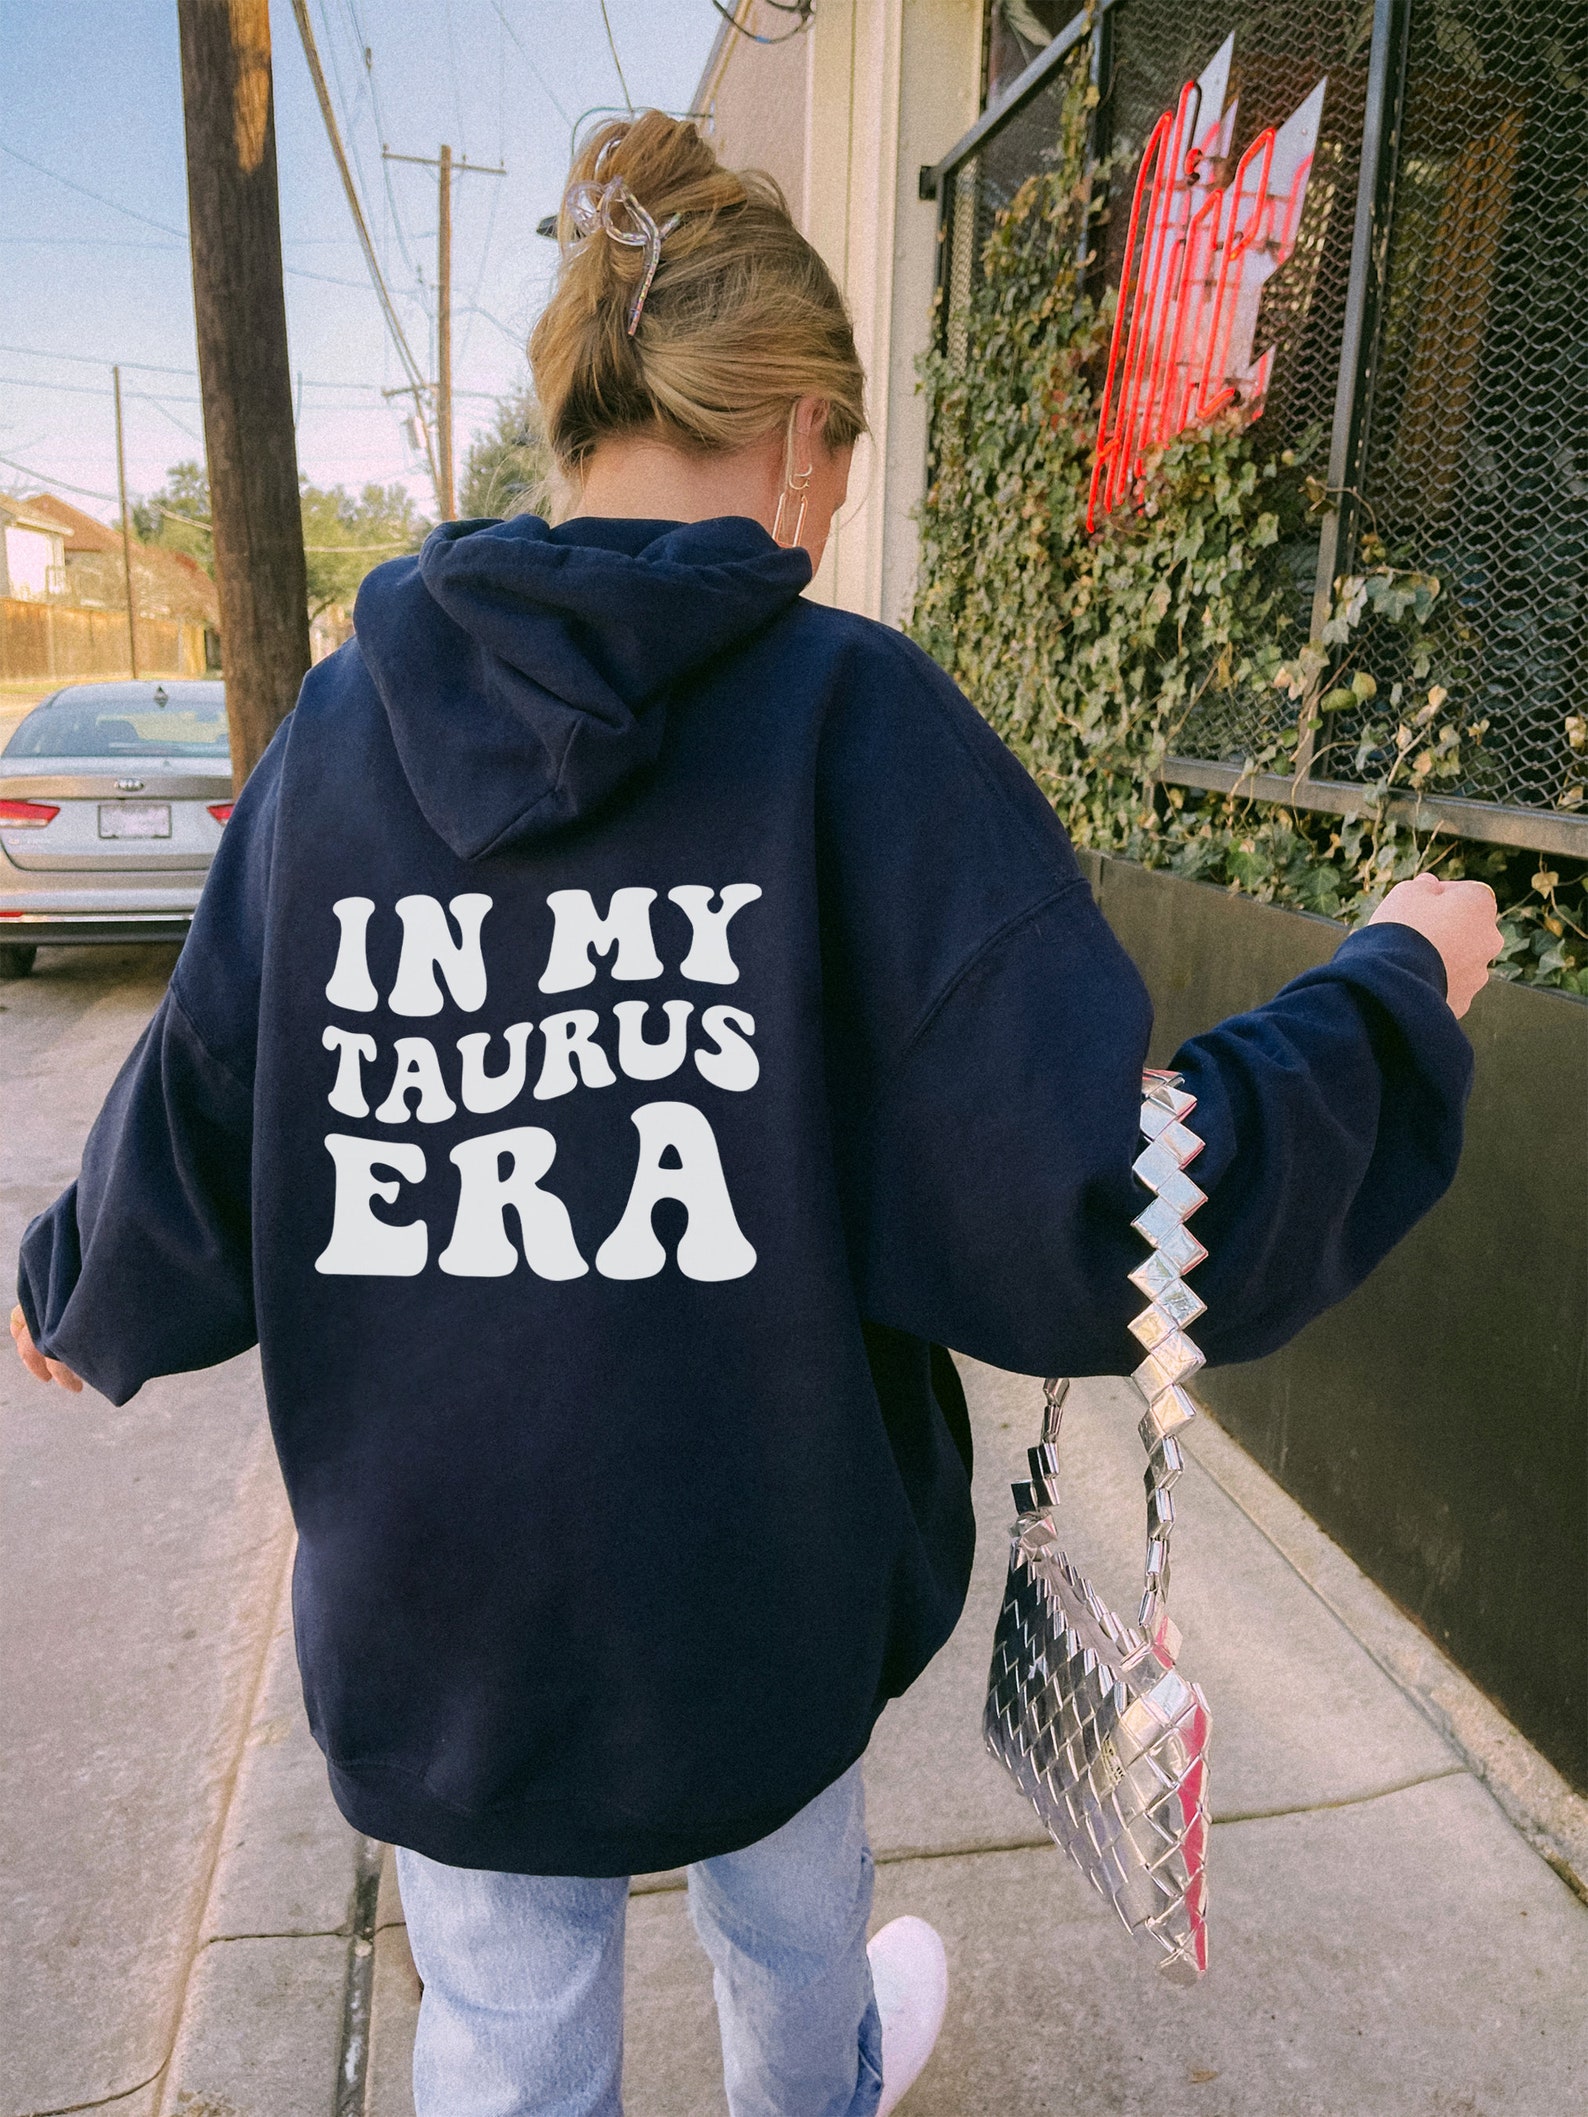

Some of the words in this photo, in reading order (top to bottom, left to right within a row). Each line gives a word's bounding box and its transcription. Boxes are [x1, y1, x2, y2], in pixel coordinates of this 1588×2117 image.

[325, 893, 493, 1017] IN
[538, 883, 763, 994] MY
[321, 999, 760, 1124] TAURUS
[314, 1101, 757, 1282] ERA
